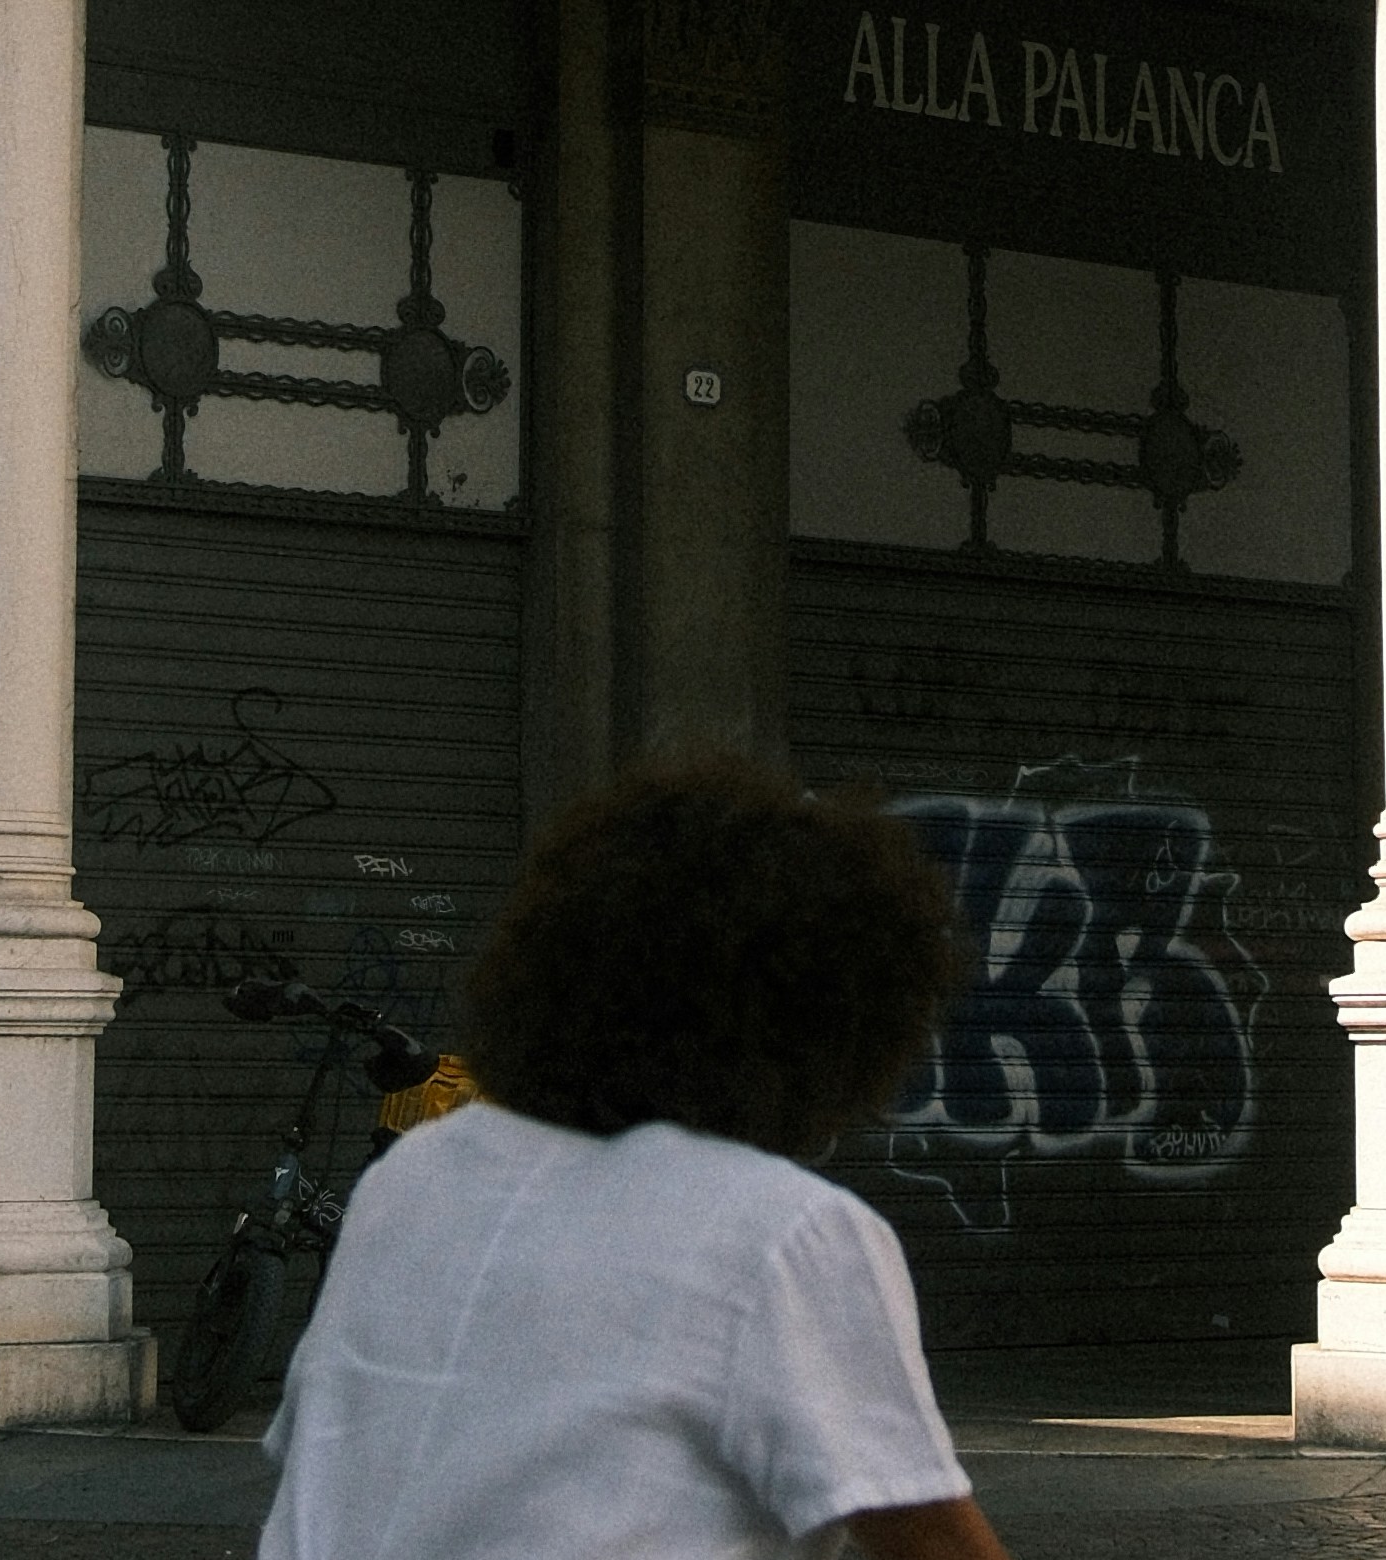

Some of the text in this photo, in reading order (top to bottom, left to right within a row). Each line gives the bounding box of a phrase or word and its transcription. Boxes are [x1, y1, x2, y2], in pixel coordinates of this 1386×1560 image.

[843, 10, 1283, 173] ALLA PALANCA
[694, 375, 715, 399] 22
